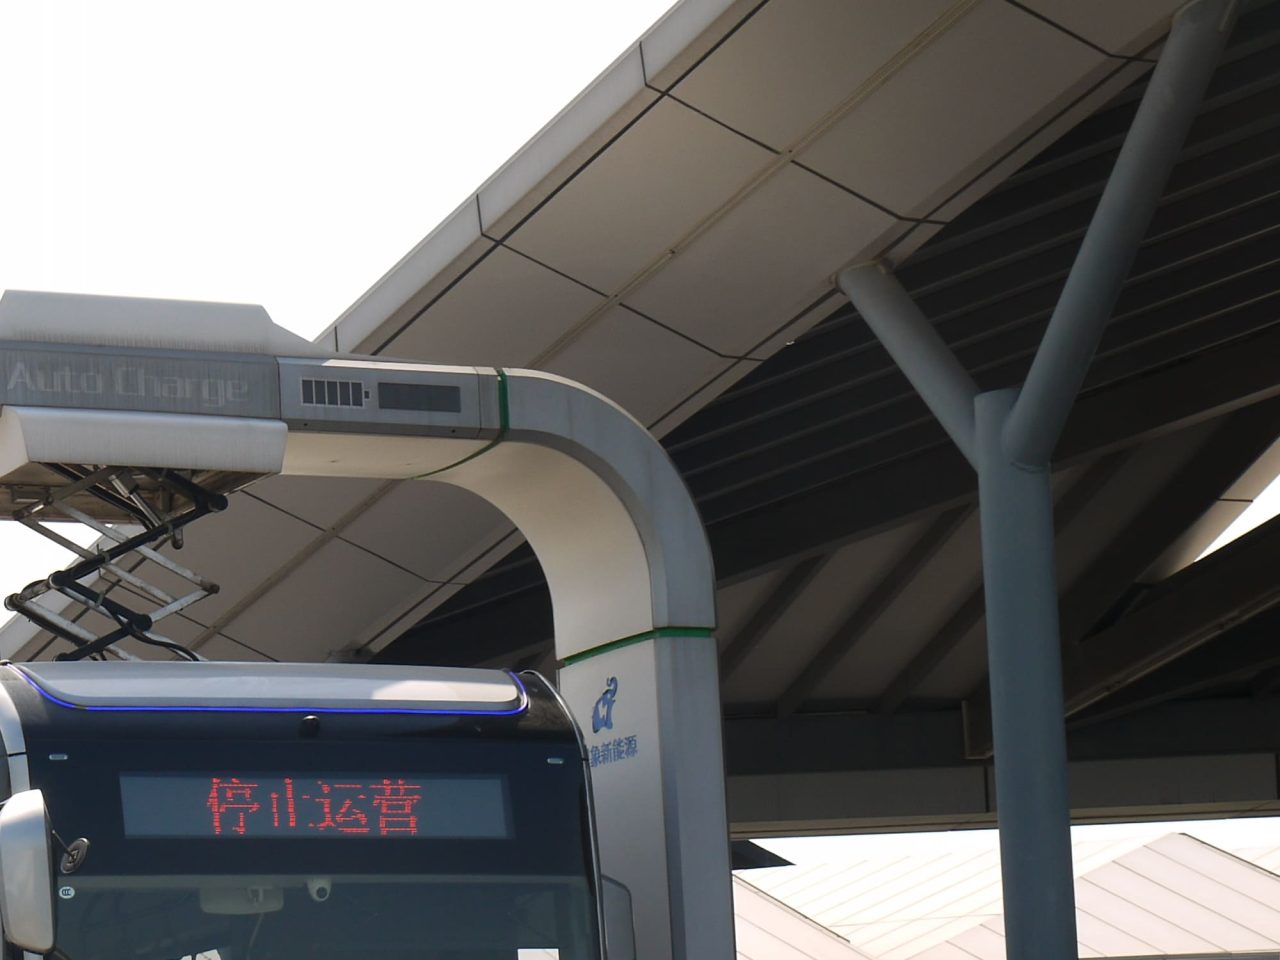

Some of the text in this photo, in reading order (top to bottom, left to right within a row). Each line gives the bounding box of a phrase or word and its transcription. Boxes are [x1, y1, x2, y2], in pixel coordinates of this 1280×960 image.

[7, 361, 248, 407] Auto Charge
[589, 734, 639, 768] 象新能源
[207, 777, 422, 835] 停止运营
